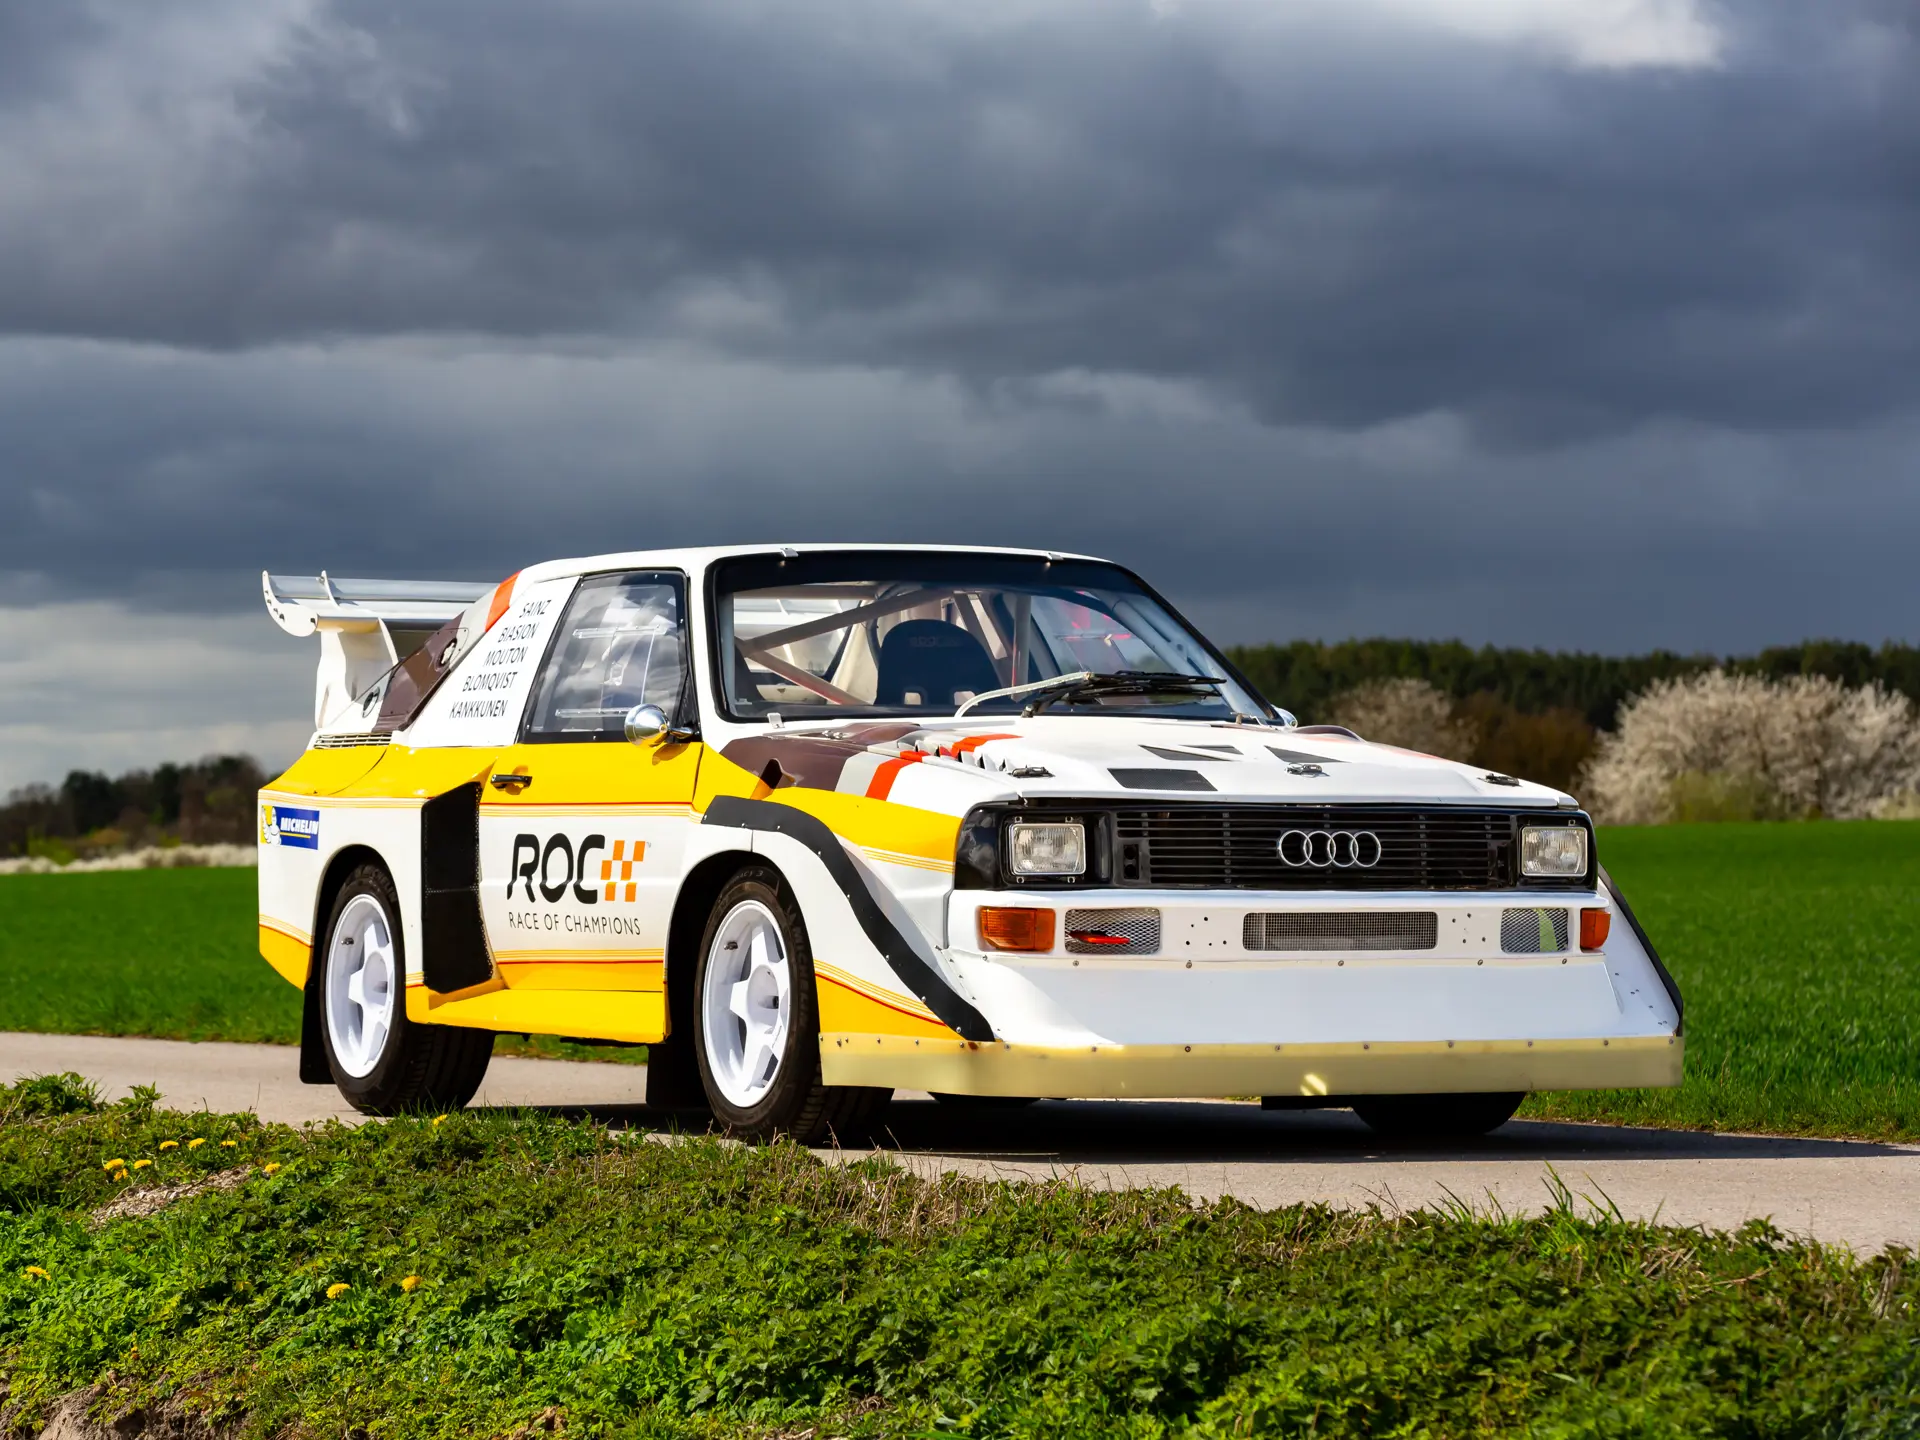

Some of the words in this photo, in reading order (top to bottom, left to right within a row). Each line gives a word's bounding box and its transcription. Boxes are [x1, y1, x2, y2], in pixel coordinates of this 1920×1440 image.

[519, 599, 552, 618] SAINZ
[497, 622, 540, 643] BIASION
[483, 646, 529, 667] MOUTON
[462, 671, 518, 692] BLOMQVIST
[449, 699, 509, 719] KANKKUNEN
[280, 817, 319, 835] MICHELIN
[507, 832, 606, 905] ROC
[508, 911, 539, 930] RACE
[543, 912, 561, 931] OF
[564, 914, 641, 936] CHAMPIONS
